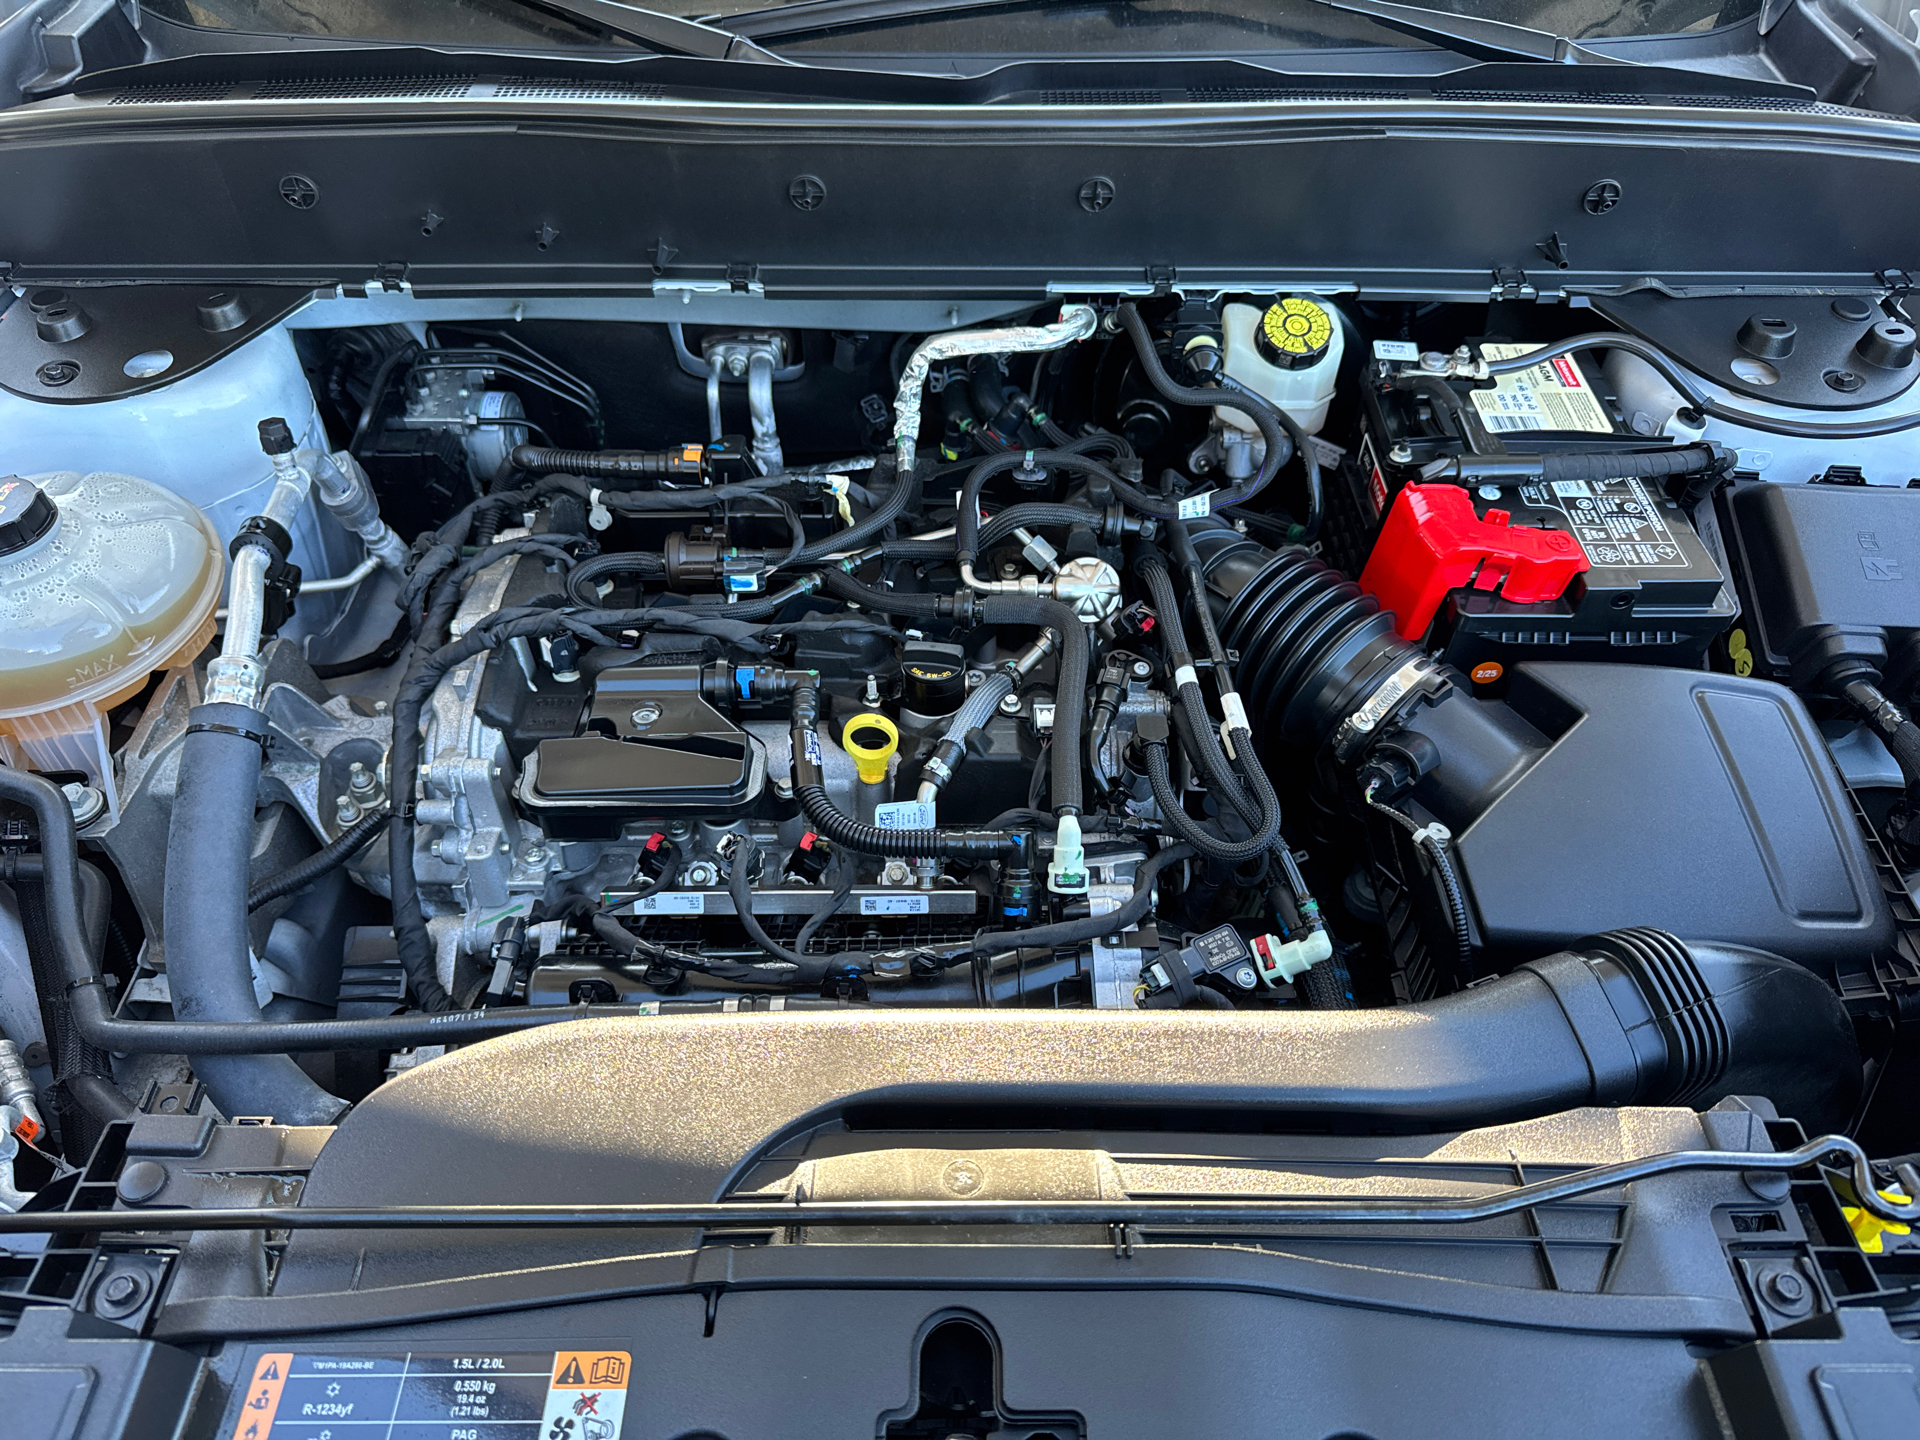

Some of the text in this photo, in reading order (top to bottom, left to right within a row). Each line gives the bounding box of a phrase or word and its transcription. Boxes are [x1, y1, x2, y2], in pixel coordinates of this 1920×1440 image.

[1538, 364, 1554, 382] AGM
[1558, 360, 1577, 386] Motorcraft
[1630, 479, 1664, 532] DANGER/POISON
[75, 654, 121, 682] MAX
[911, 667, 952, 679] SAE 5W-20
[1476, 669, 1498, 678] 2/25
[453, 1358, 475, 1369] 1.5L
[482, 1358, 505, 1369] 2.0L
[454, 1380, 496, 1395] 0.550 kg
[457, 1394, 487, 1404] 19.4 oz
[302, 1403, 354, 1418] R-1234yf
[450, 1405, 489, 1418] (1.21 lbs)
[451, 1429, 477, 1440] PAG
